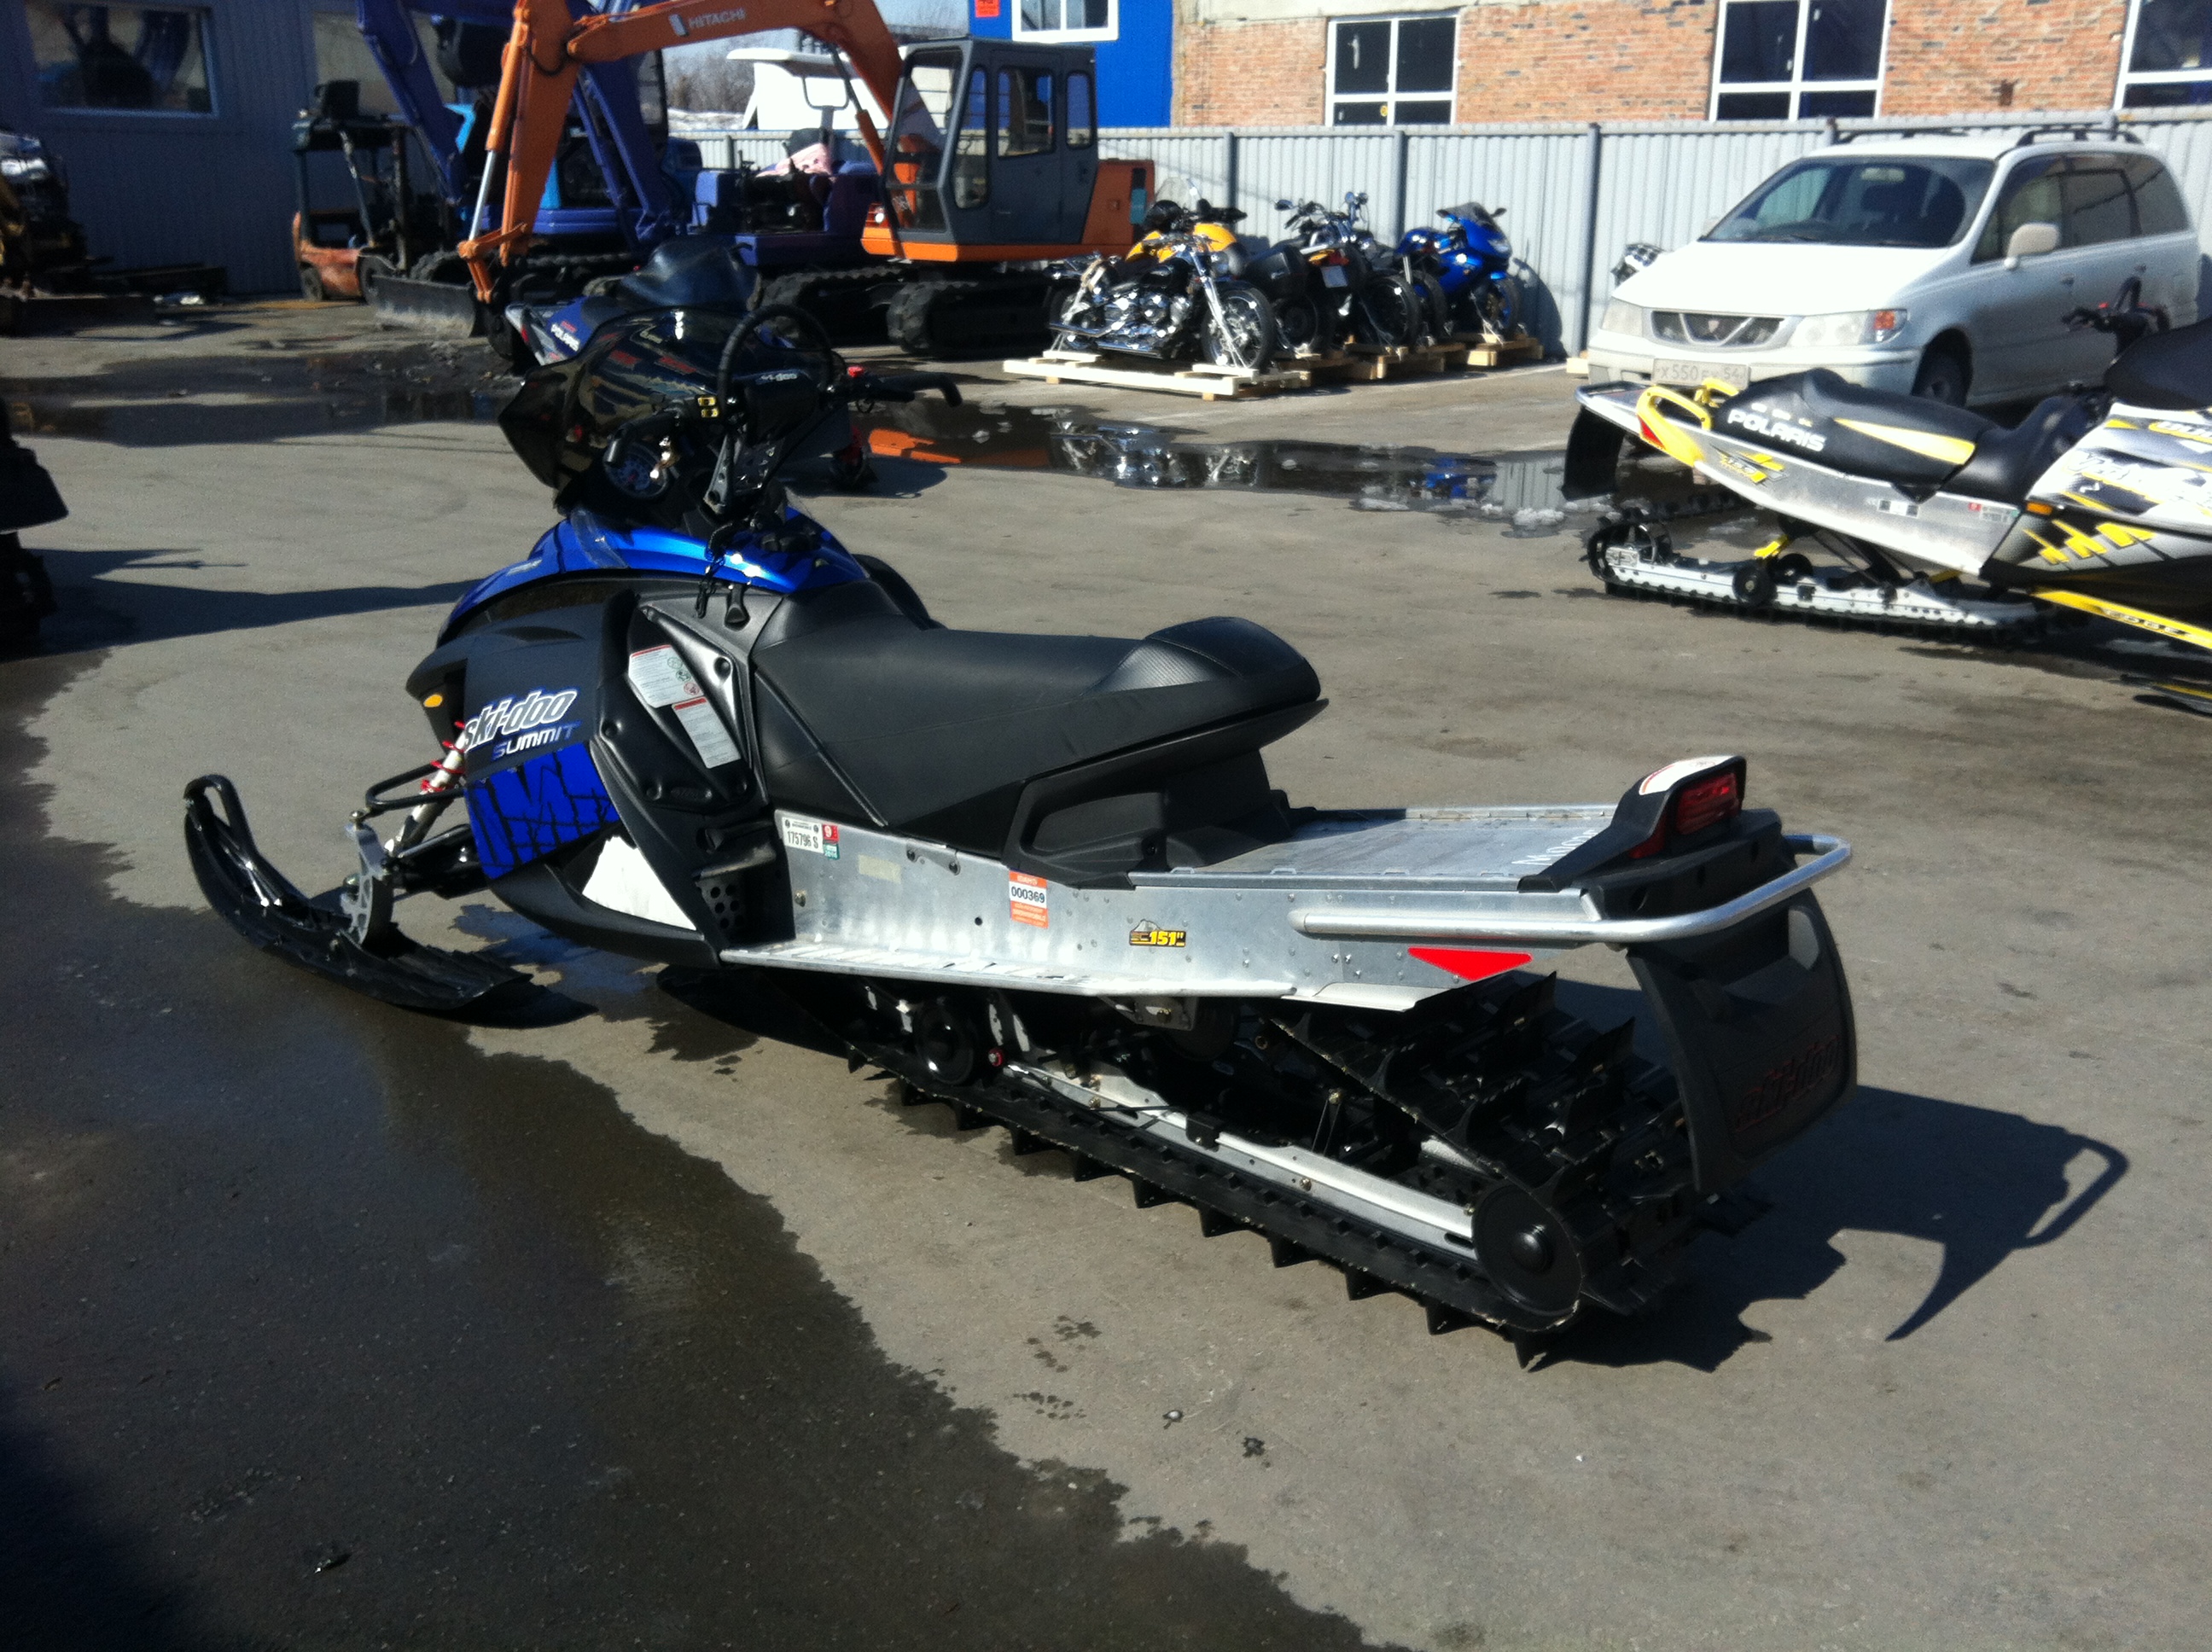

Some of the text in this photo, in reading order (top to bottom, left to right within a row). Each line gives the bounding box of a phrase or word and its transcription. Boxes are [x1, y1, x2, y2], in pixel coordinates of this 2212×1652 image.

[689, 8, 746, 28] HITACHI
[1727, 409, 1825, 451] POLARIS
[463, 689, 578, 753] ski-doo
[492, 721, 582, 760] SUMMIT
[812, 835, 819, 849] S
[1011, 886, 1045, 904] 000369
